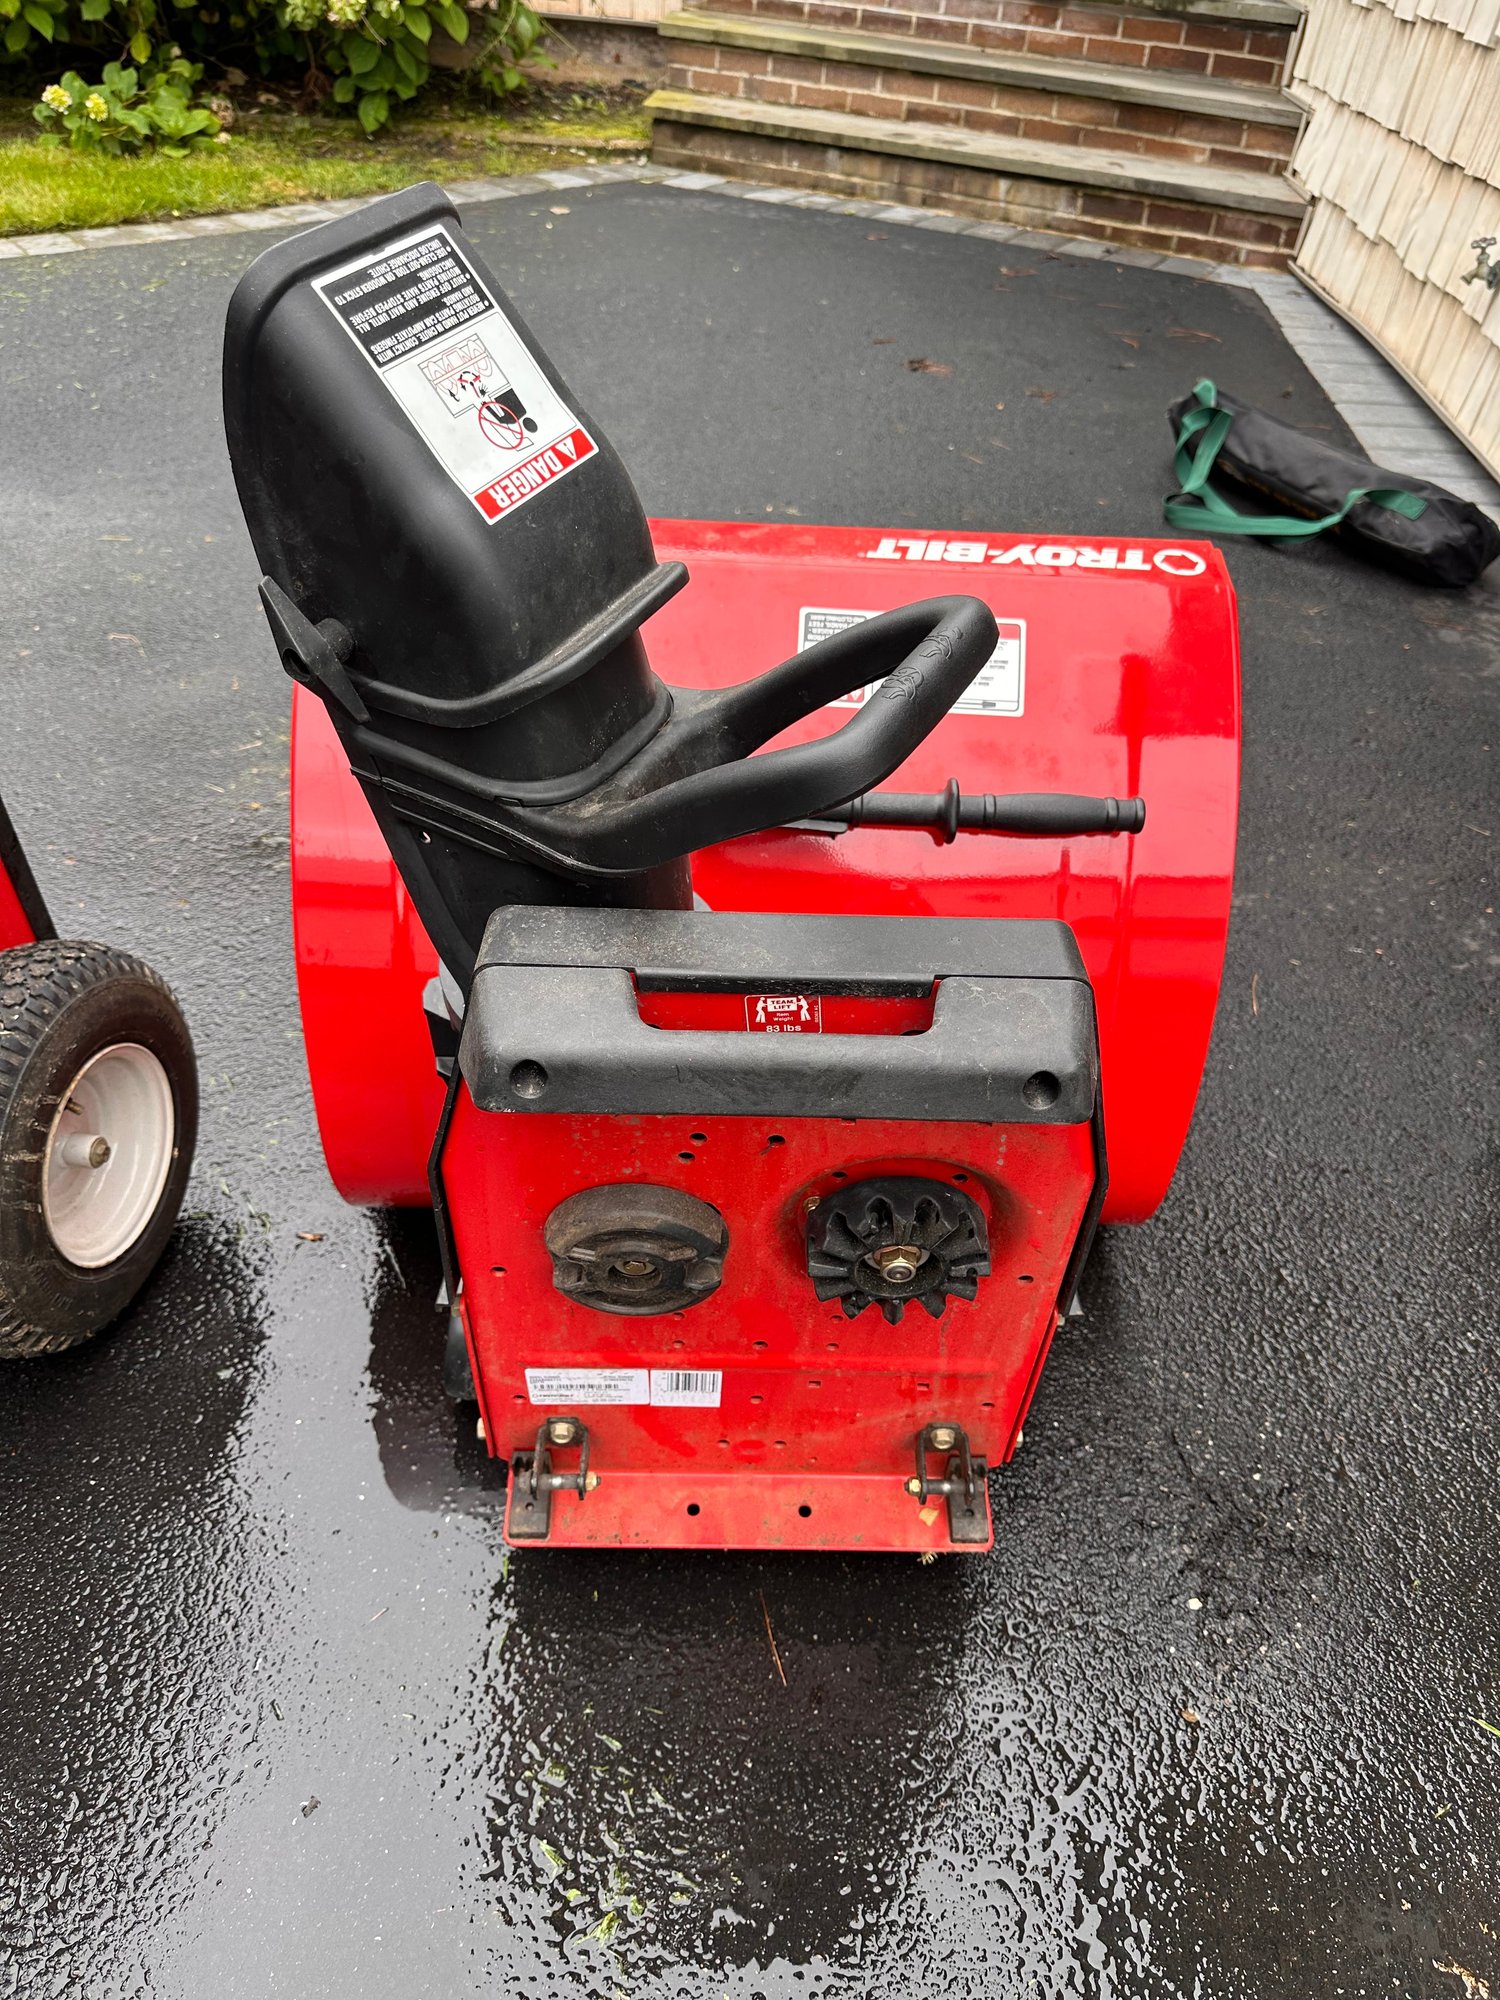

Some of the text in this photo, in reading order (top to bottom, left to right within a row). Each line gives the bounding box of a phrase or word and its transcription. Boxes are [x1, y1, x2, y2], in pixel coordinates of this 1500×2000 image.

[333, 246, 448, 305] USE CLEAN-OUT TOOL OR WOODEN STICK TO
[366, 238, 442, 278] UNCLOG DISCHARGE CHUTE.
[416, 257, 456, 281] UNCLOGGING.
[348, 265, 461, 326] MOVING PARTS HAVE STOPPED BEFORE
[354, 274, 467, 334] SHUT OFF ENGINE AND WAIT UNTIL ALL
[369, 292, 480, 354] ROTATING PARTS CAN AMPUTATE FINGERS
[440, 284, 475, 307] AND HANDS.
[375, 300, 486, 363] NEVER PUT HAND IN CHUTE. CONTACT WITH
[486, 448, 565, 510] DANGER
[866, 538, 1151, 570] TROY-BILT
